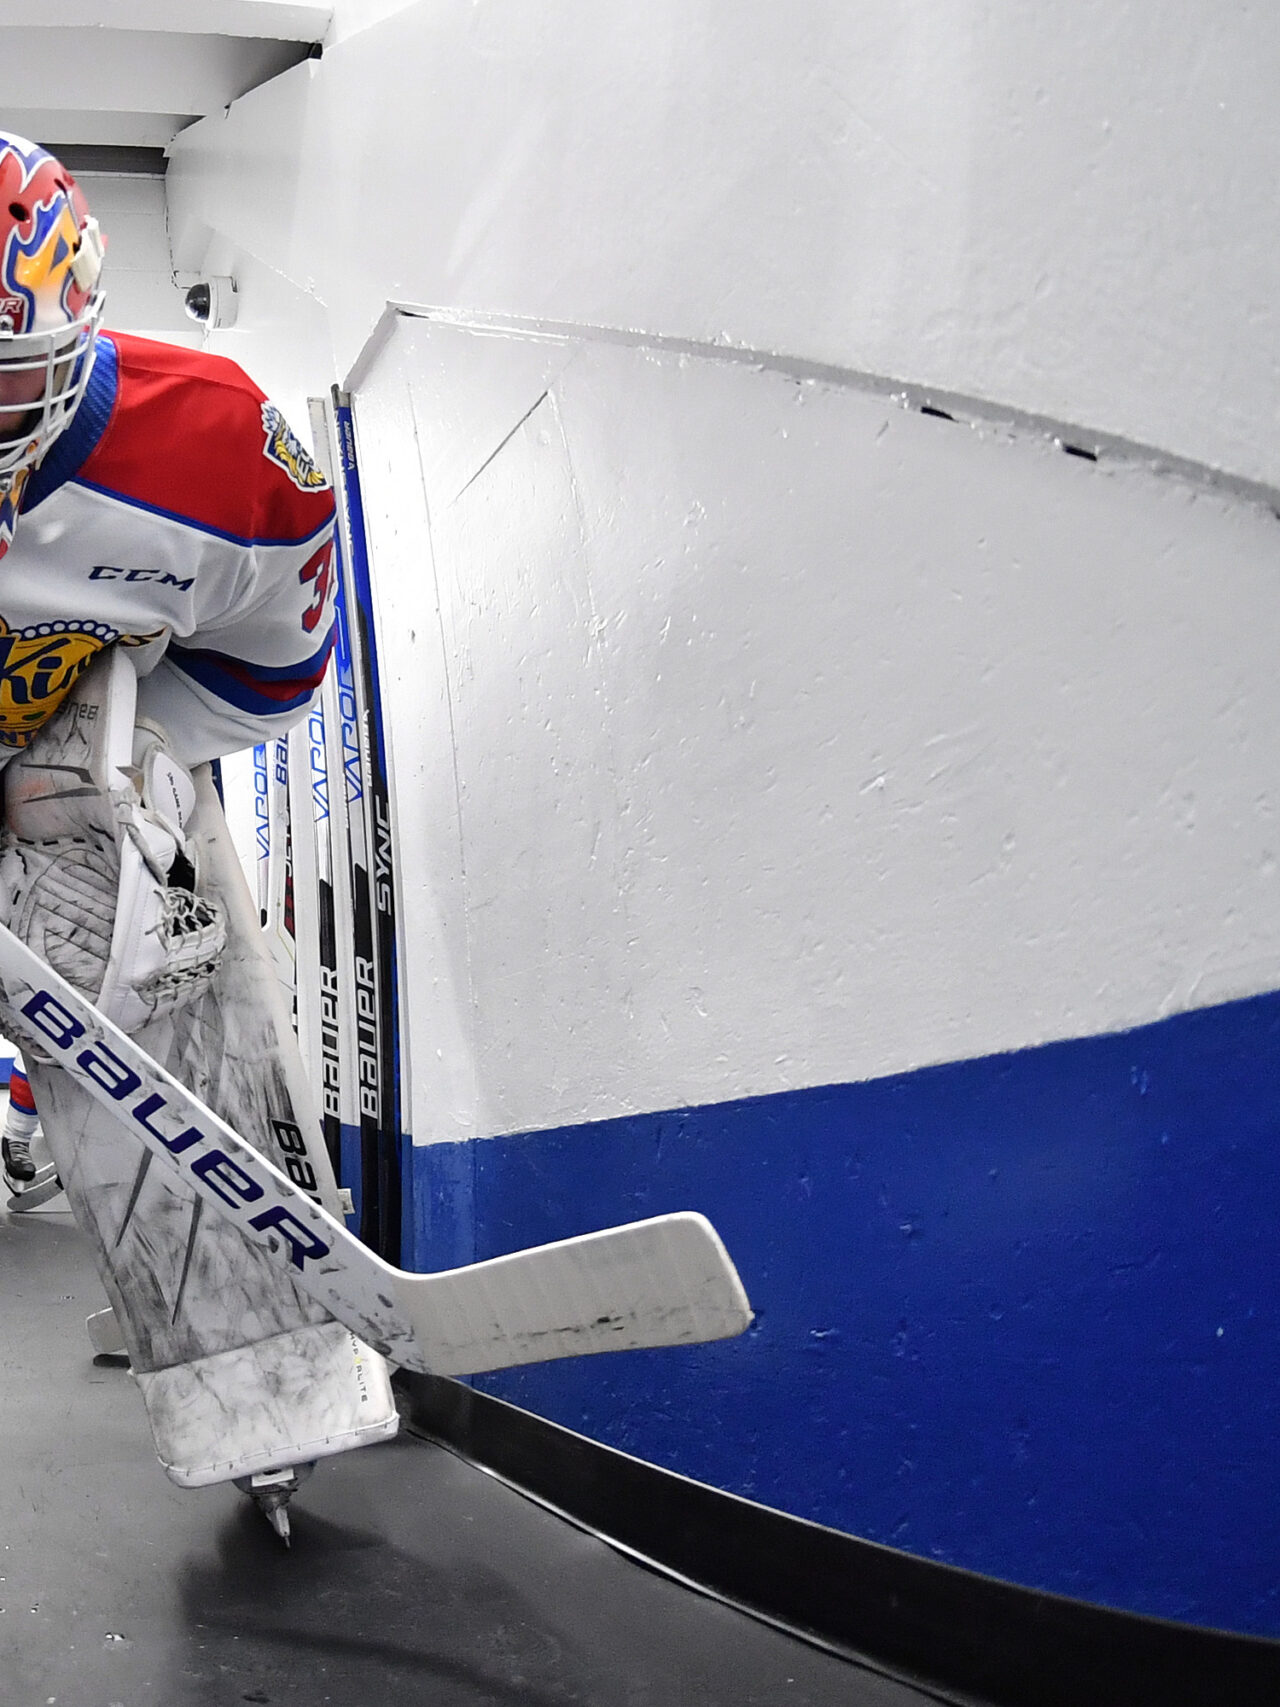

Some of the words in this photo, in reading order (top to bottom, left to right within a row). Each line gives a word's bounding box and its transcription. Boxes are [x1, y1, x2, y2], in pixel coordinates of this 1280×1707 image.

[88, 566, 195, 592] CCM
[298, 538, 336, 634] 3
[308, 711, 330, 823] VAPO
[375, 795, 394, 916] SYNC
[320, 965, 340, 1119] BAUER
[355, 956, 379, 1120] BAUER
[21, 990, 330, 1272] BAUER
